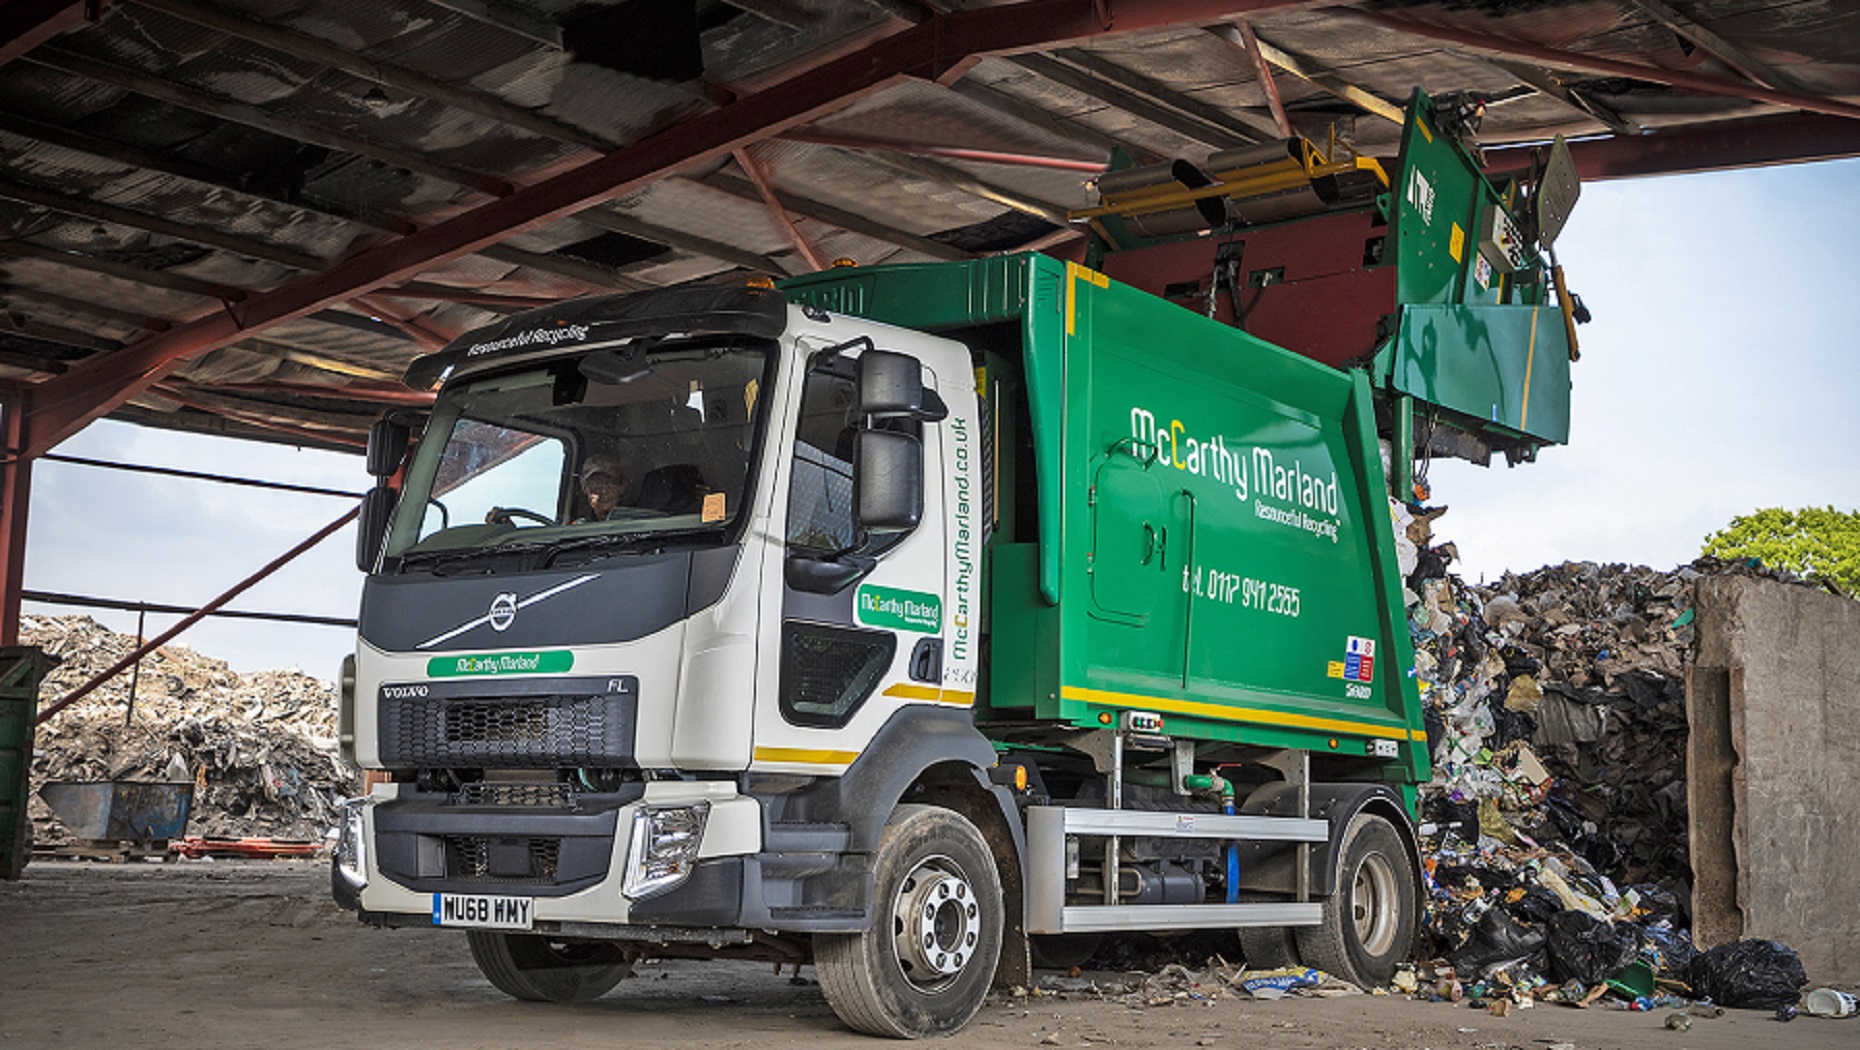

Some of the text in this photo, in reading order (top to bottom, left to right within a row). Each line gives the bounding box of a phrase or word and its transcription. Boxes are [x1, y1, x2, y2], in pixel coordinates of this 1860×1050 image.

[467, 324, 590, 356] Resourceful Recycling
[1130, 406, 1338, 516] McCarthy Marland
[1254, 499, 1302, 528] Resourceful
[952, 417, 973, 660] McCarthyMarland.co.uk
[1207, 568, 1240, 604] 0117
[1242, 577, 1267, 610] 941
[1267, 583, 1301, 617] 2555
[861, 593, 939, 621] McCarthy Marland
[456, 653, 540, 674] McCarthy Marland
[382, 685, 430, 699] VOLVO
[606, 679, 629, 693] FL
[444, 896, 488, 922] WU68
